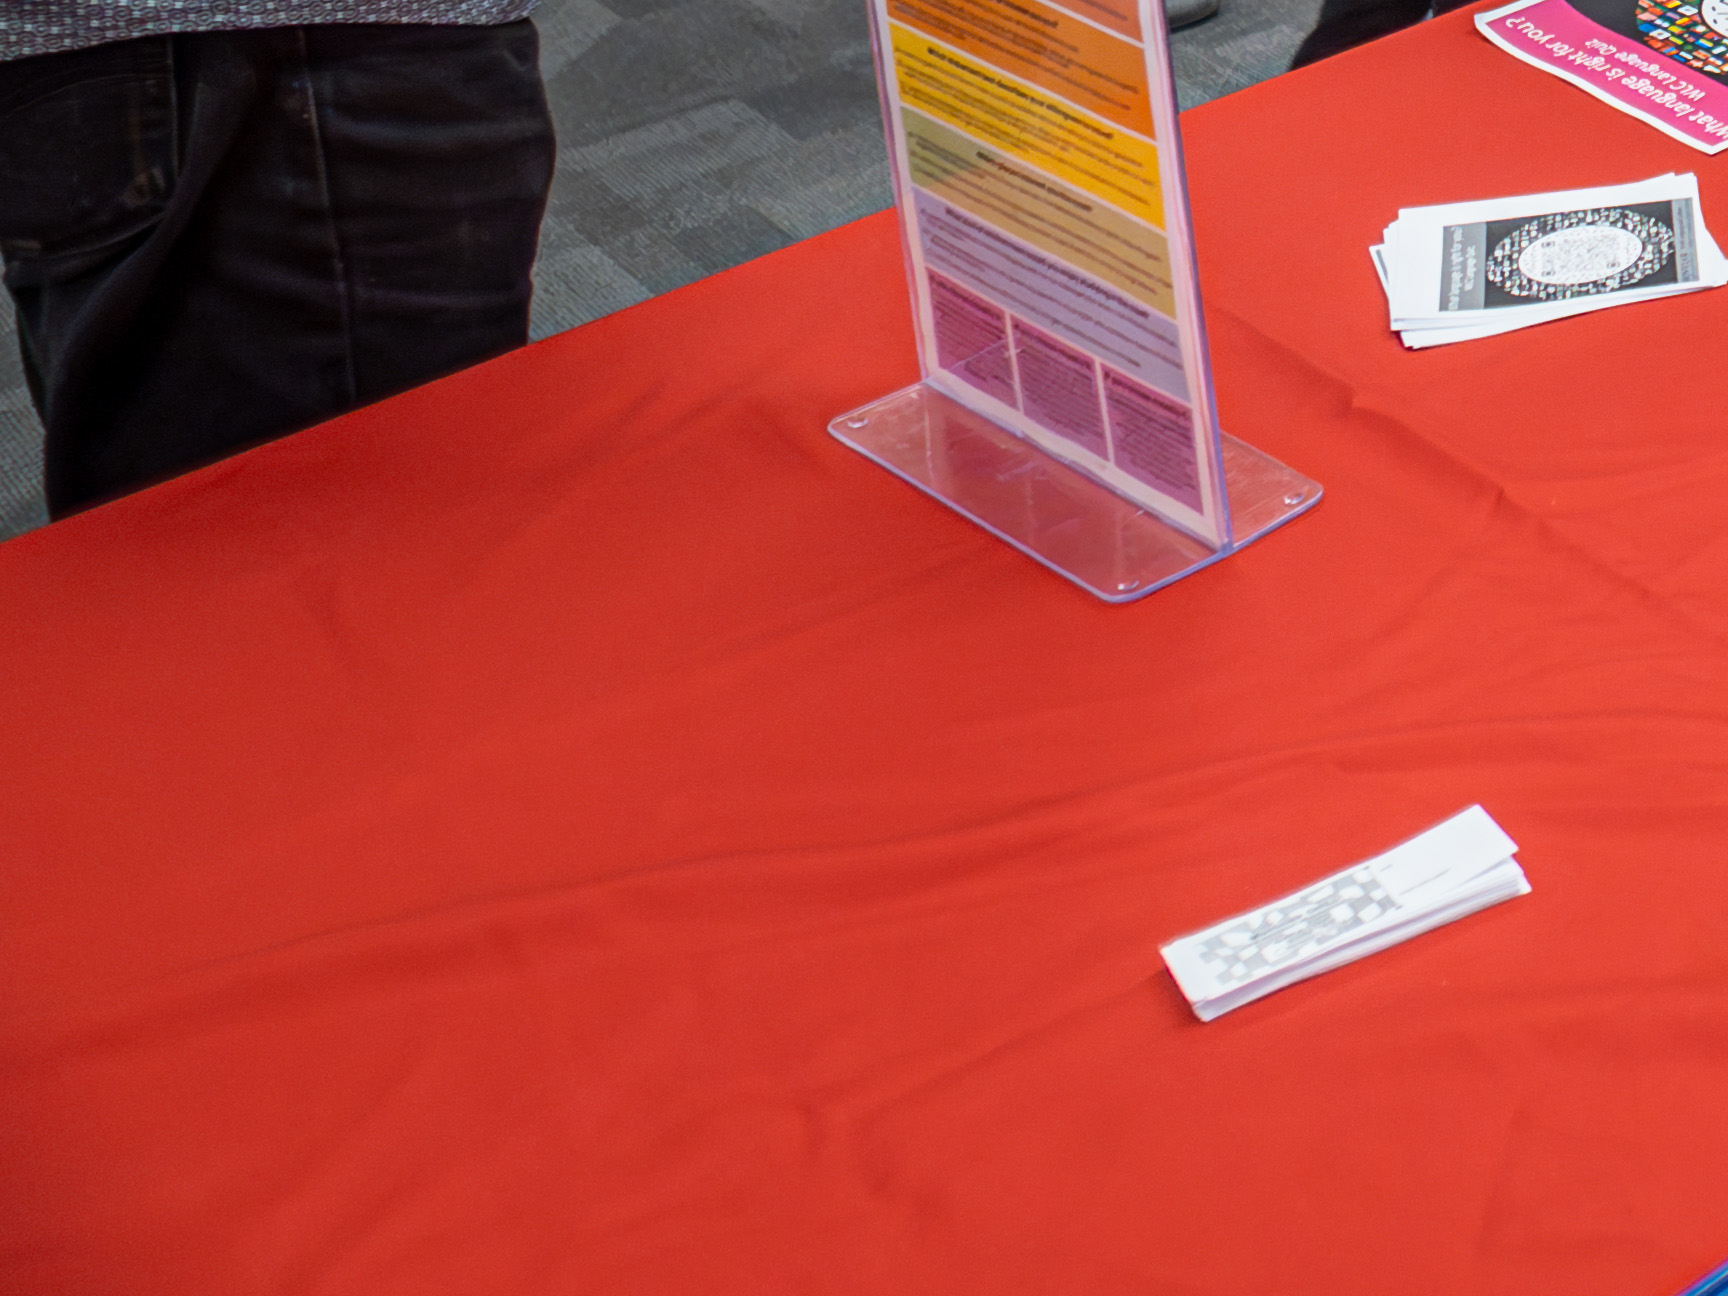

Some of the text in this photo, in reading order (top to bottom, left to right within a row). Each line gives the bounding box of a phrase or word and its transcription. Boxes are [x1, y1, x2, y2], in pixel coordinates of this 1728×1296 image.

[1505, 16, 1556, 44] you?
[1546, 40, 1571, 57] for
[1567, 50, 1611, 73] right
[1585, 38, 1706, 102] WLC Language Quiz
[1606, 67, 1627, 81] is
[1620, 75, 1696, 117] language
